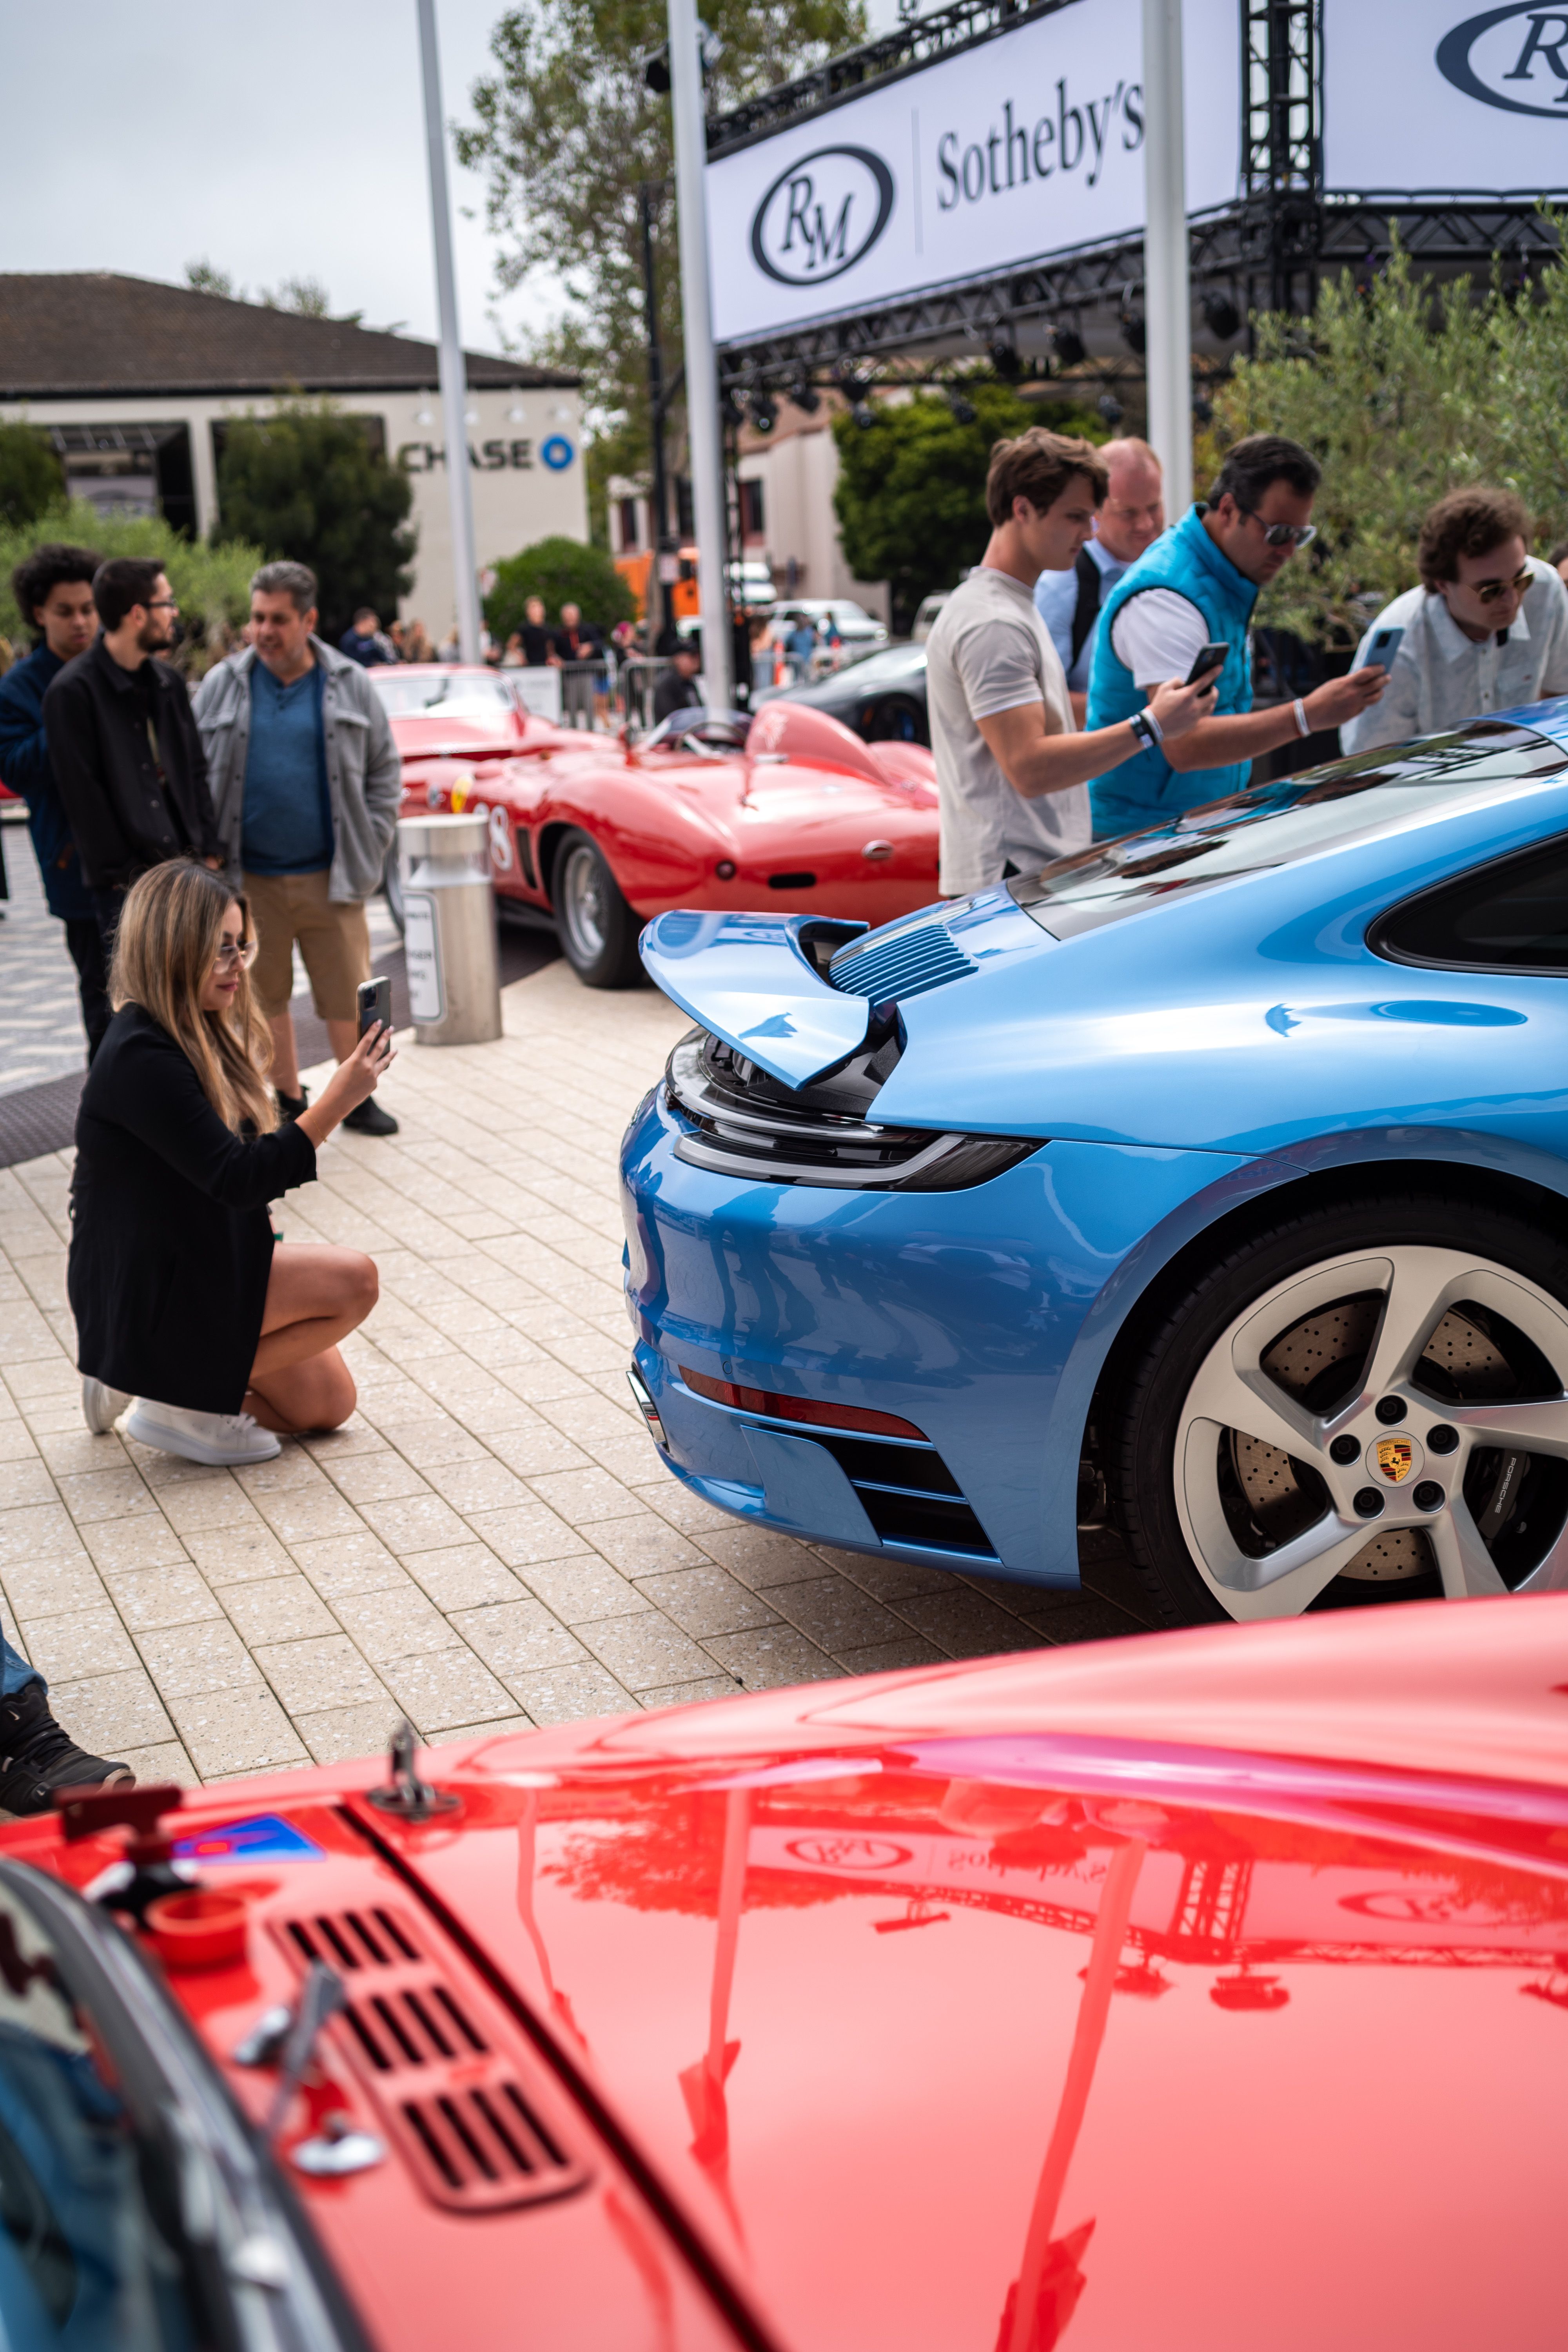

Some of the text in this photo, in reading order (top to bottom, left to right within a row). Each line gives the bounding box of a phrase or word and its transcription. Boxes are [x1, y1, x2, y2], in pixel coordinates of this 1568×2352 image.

[1502, 14, 1568, 102] R
[780, 76, 1145, 270] RM Sotheby's
[1495, 1457, 1517, 1514] PORSCHE
